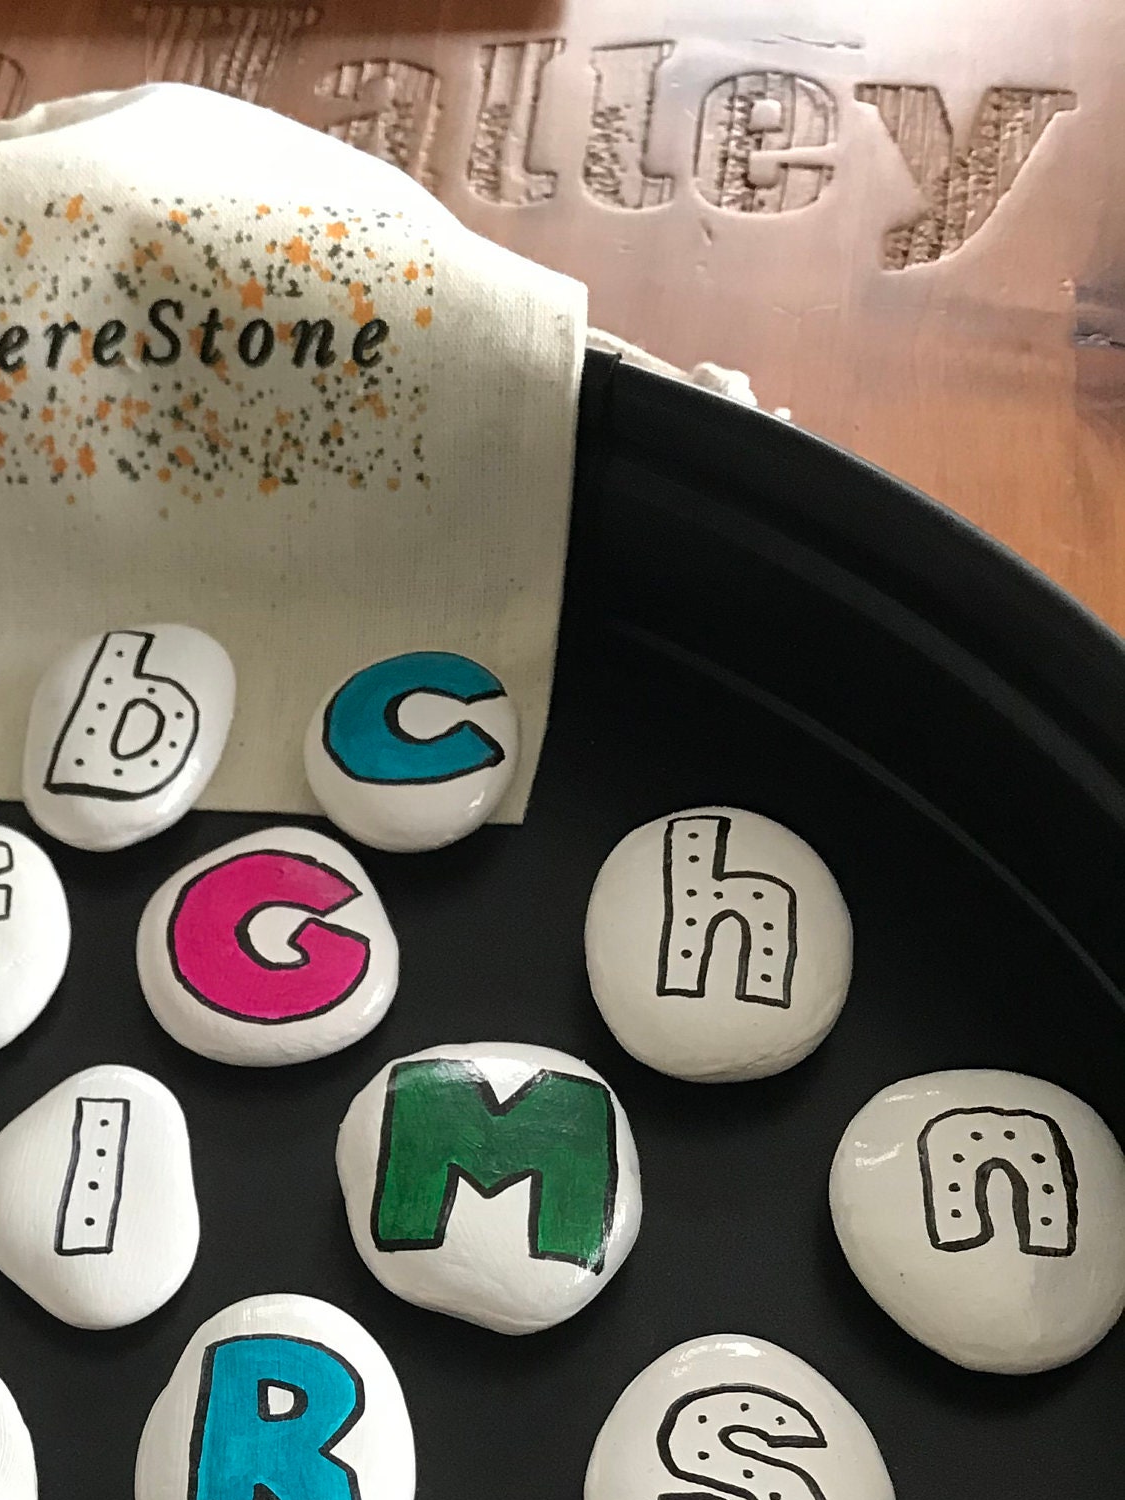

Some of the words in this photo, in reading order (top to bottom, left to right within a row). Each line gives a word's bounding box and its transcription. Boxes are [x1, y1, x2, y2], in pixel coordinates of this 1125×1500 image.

[43, 629, 201, 801] b
[321, 649, 507, 786] C
[167, 848, 372, 1026] G
[656, 815, 799, 1009] h
[370, 1057, 617, 1274] M
[916, 1106, 1078, 1257] n
